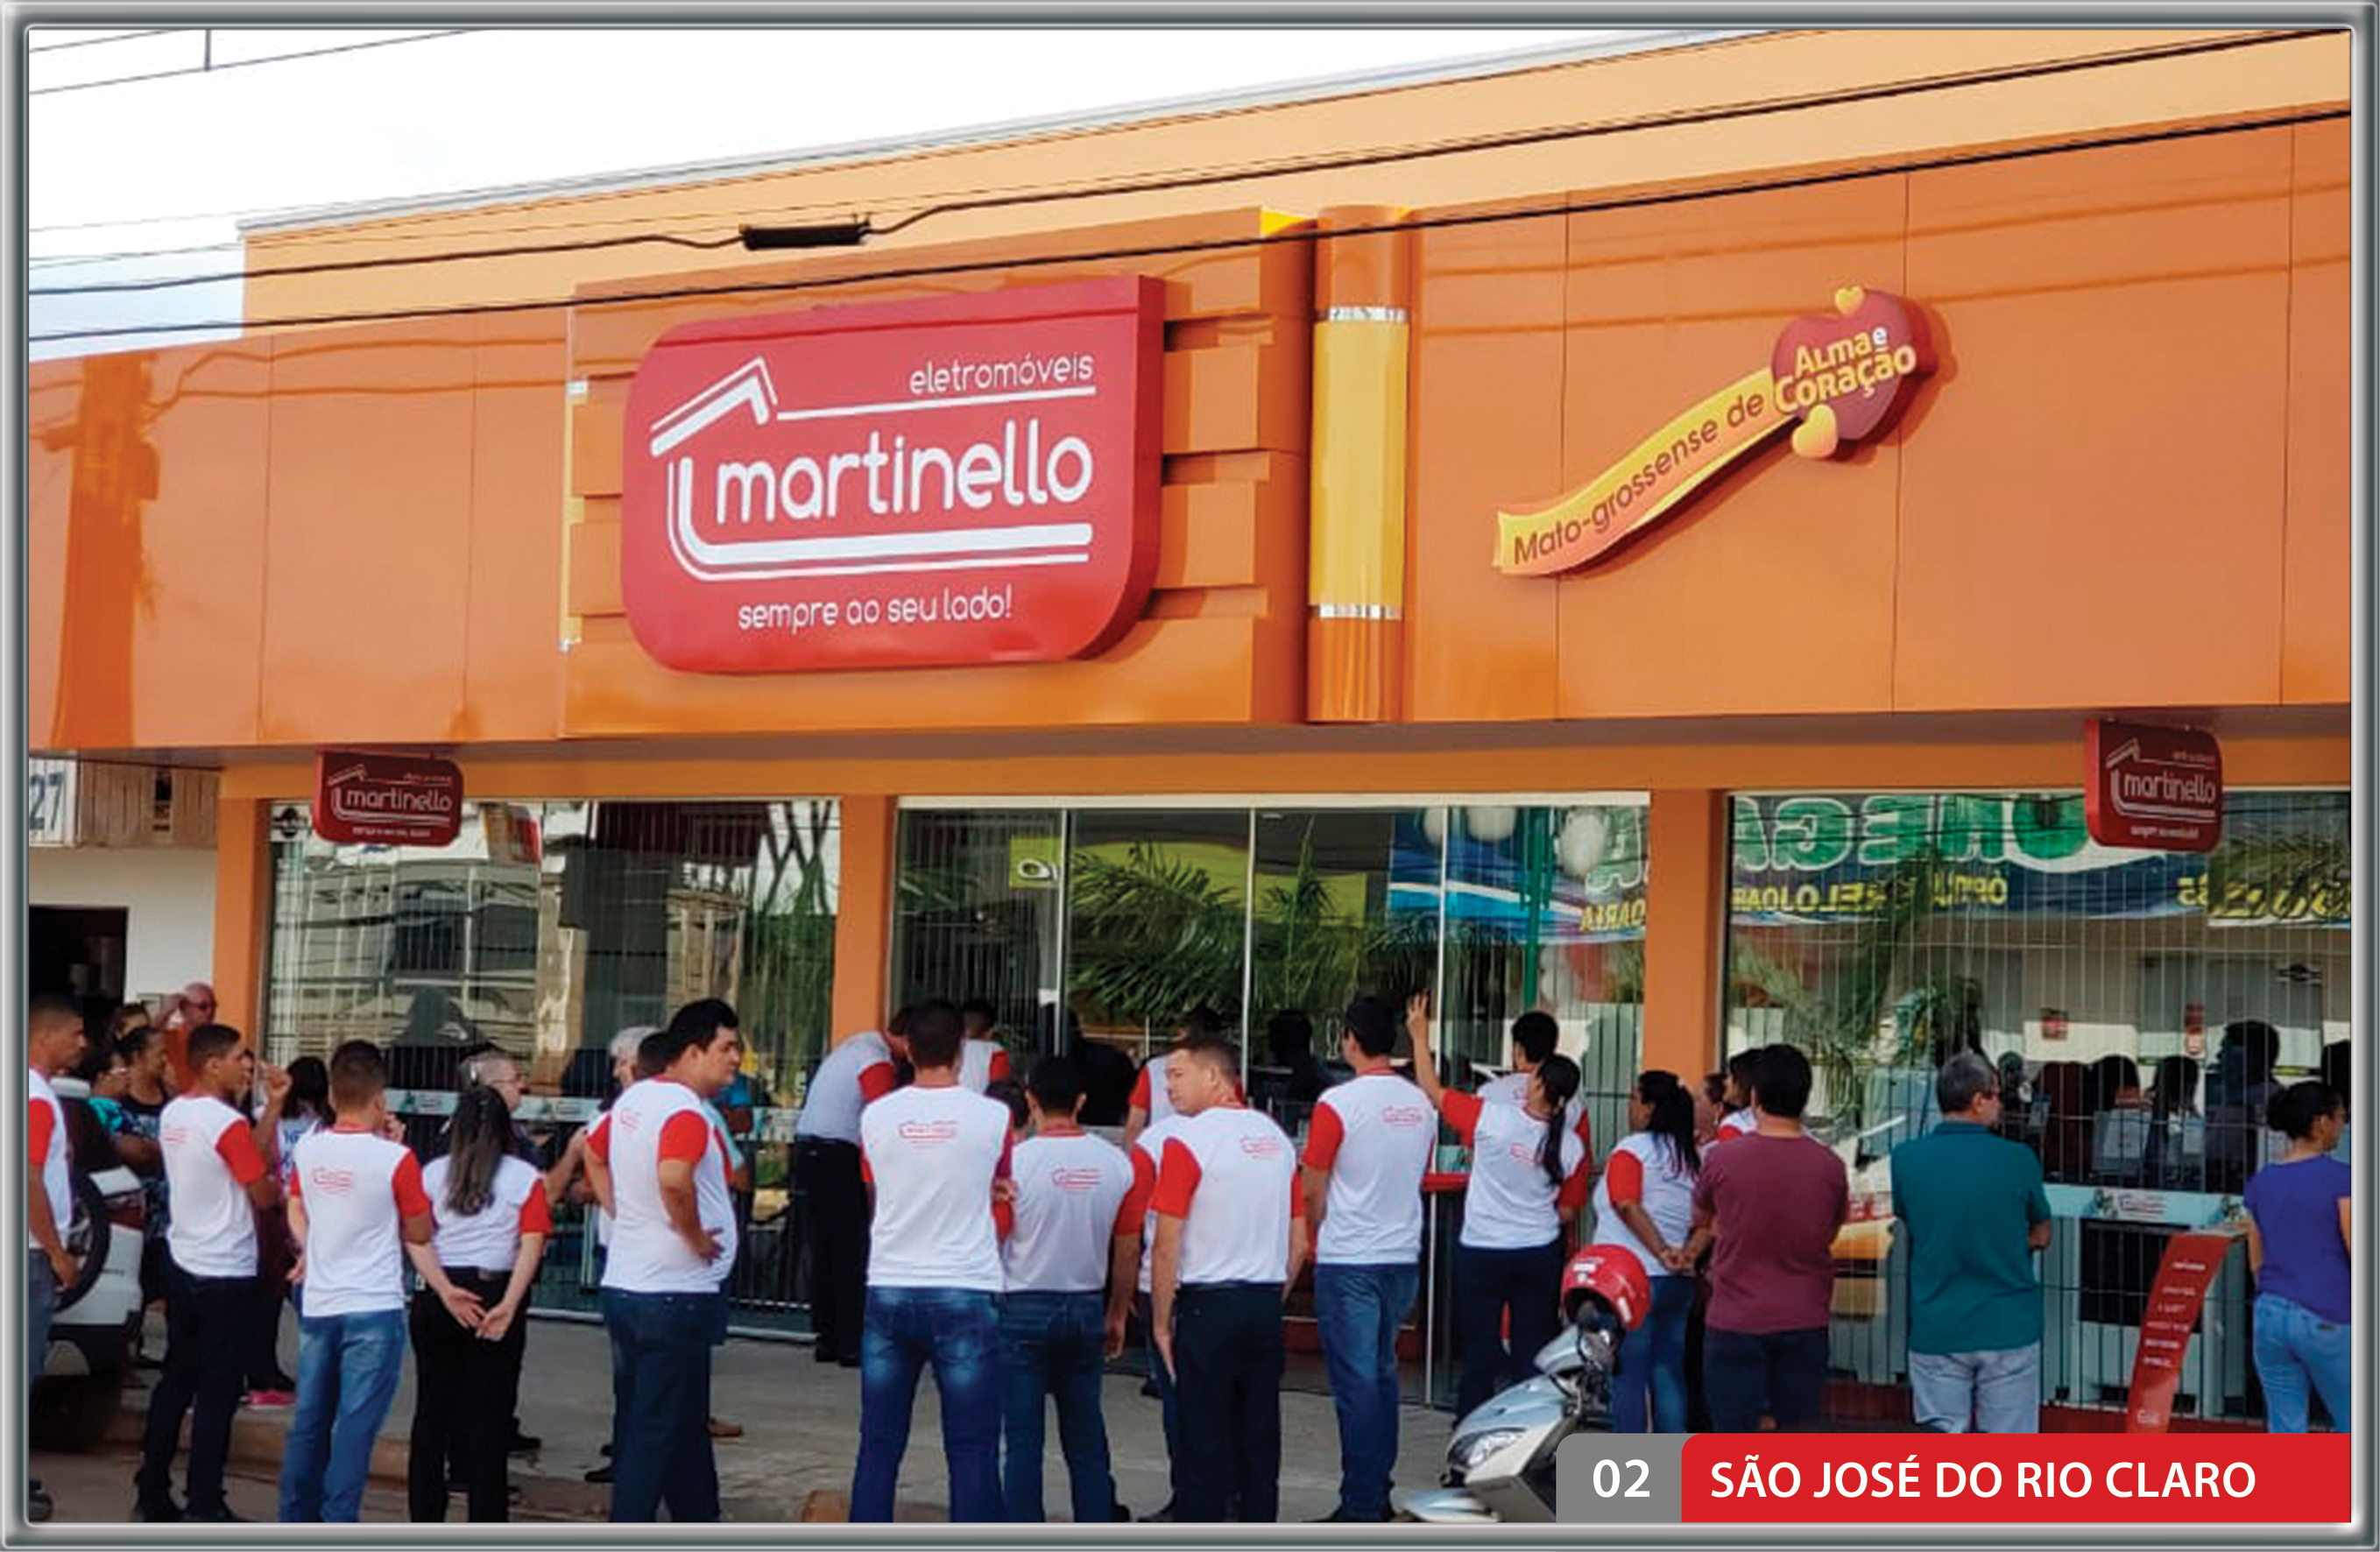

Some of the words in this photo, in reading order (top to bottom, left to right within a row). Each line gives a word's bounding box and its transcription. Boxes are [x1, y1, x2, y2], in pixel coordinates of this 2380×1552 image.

[1872, 328, 1887, 345] e
[910, 353, 1094, 395] eletromóveis
[717, 419, 1094, 525] martinello
[1515, 418, 1717, 564] Mato-grossense
[1727, 391, 1764, 428] de
[738, 596, 837, 632] sempre
[846, 597, 880, 624] ao
[887, 596, 936, 623] seu
[943, 584, 1012, 621] lado!
[347, 788, 452, 812] martinello
[2124, 770, 2216, 803] martinello
